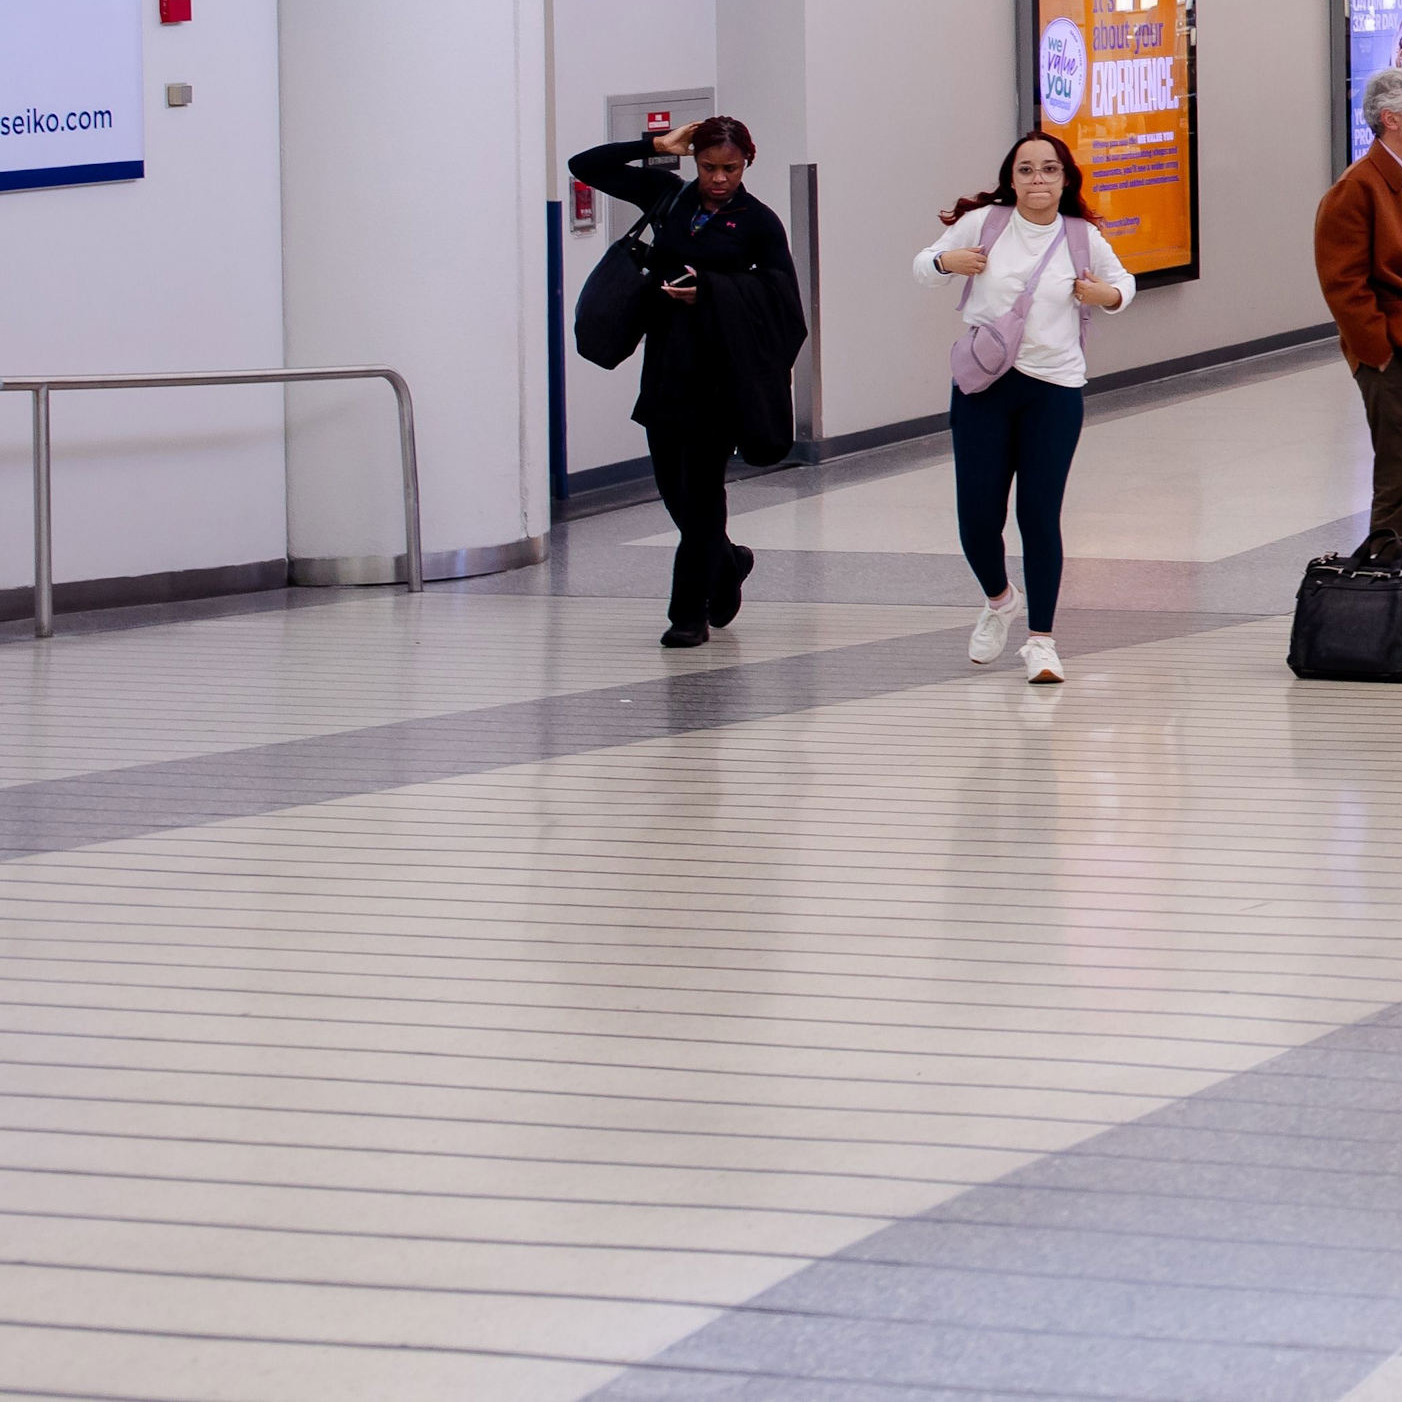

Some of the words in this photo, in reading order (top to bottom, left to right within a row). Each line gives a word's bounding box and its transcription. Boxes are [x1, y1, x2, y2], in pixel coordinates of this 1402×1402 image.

[1047, 36, 1062, 52] we
[1093, 20, 1130, 51] about
[1134, 21, 1163, 54] your
[1047, 39, 1078, 76] value
[1045, 73, 1071, 99] you
[1091, 56, 1179, 117] EXPERIENCE.
